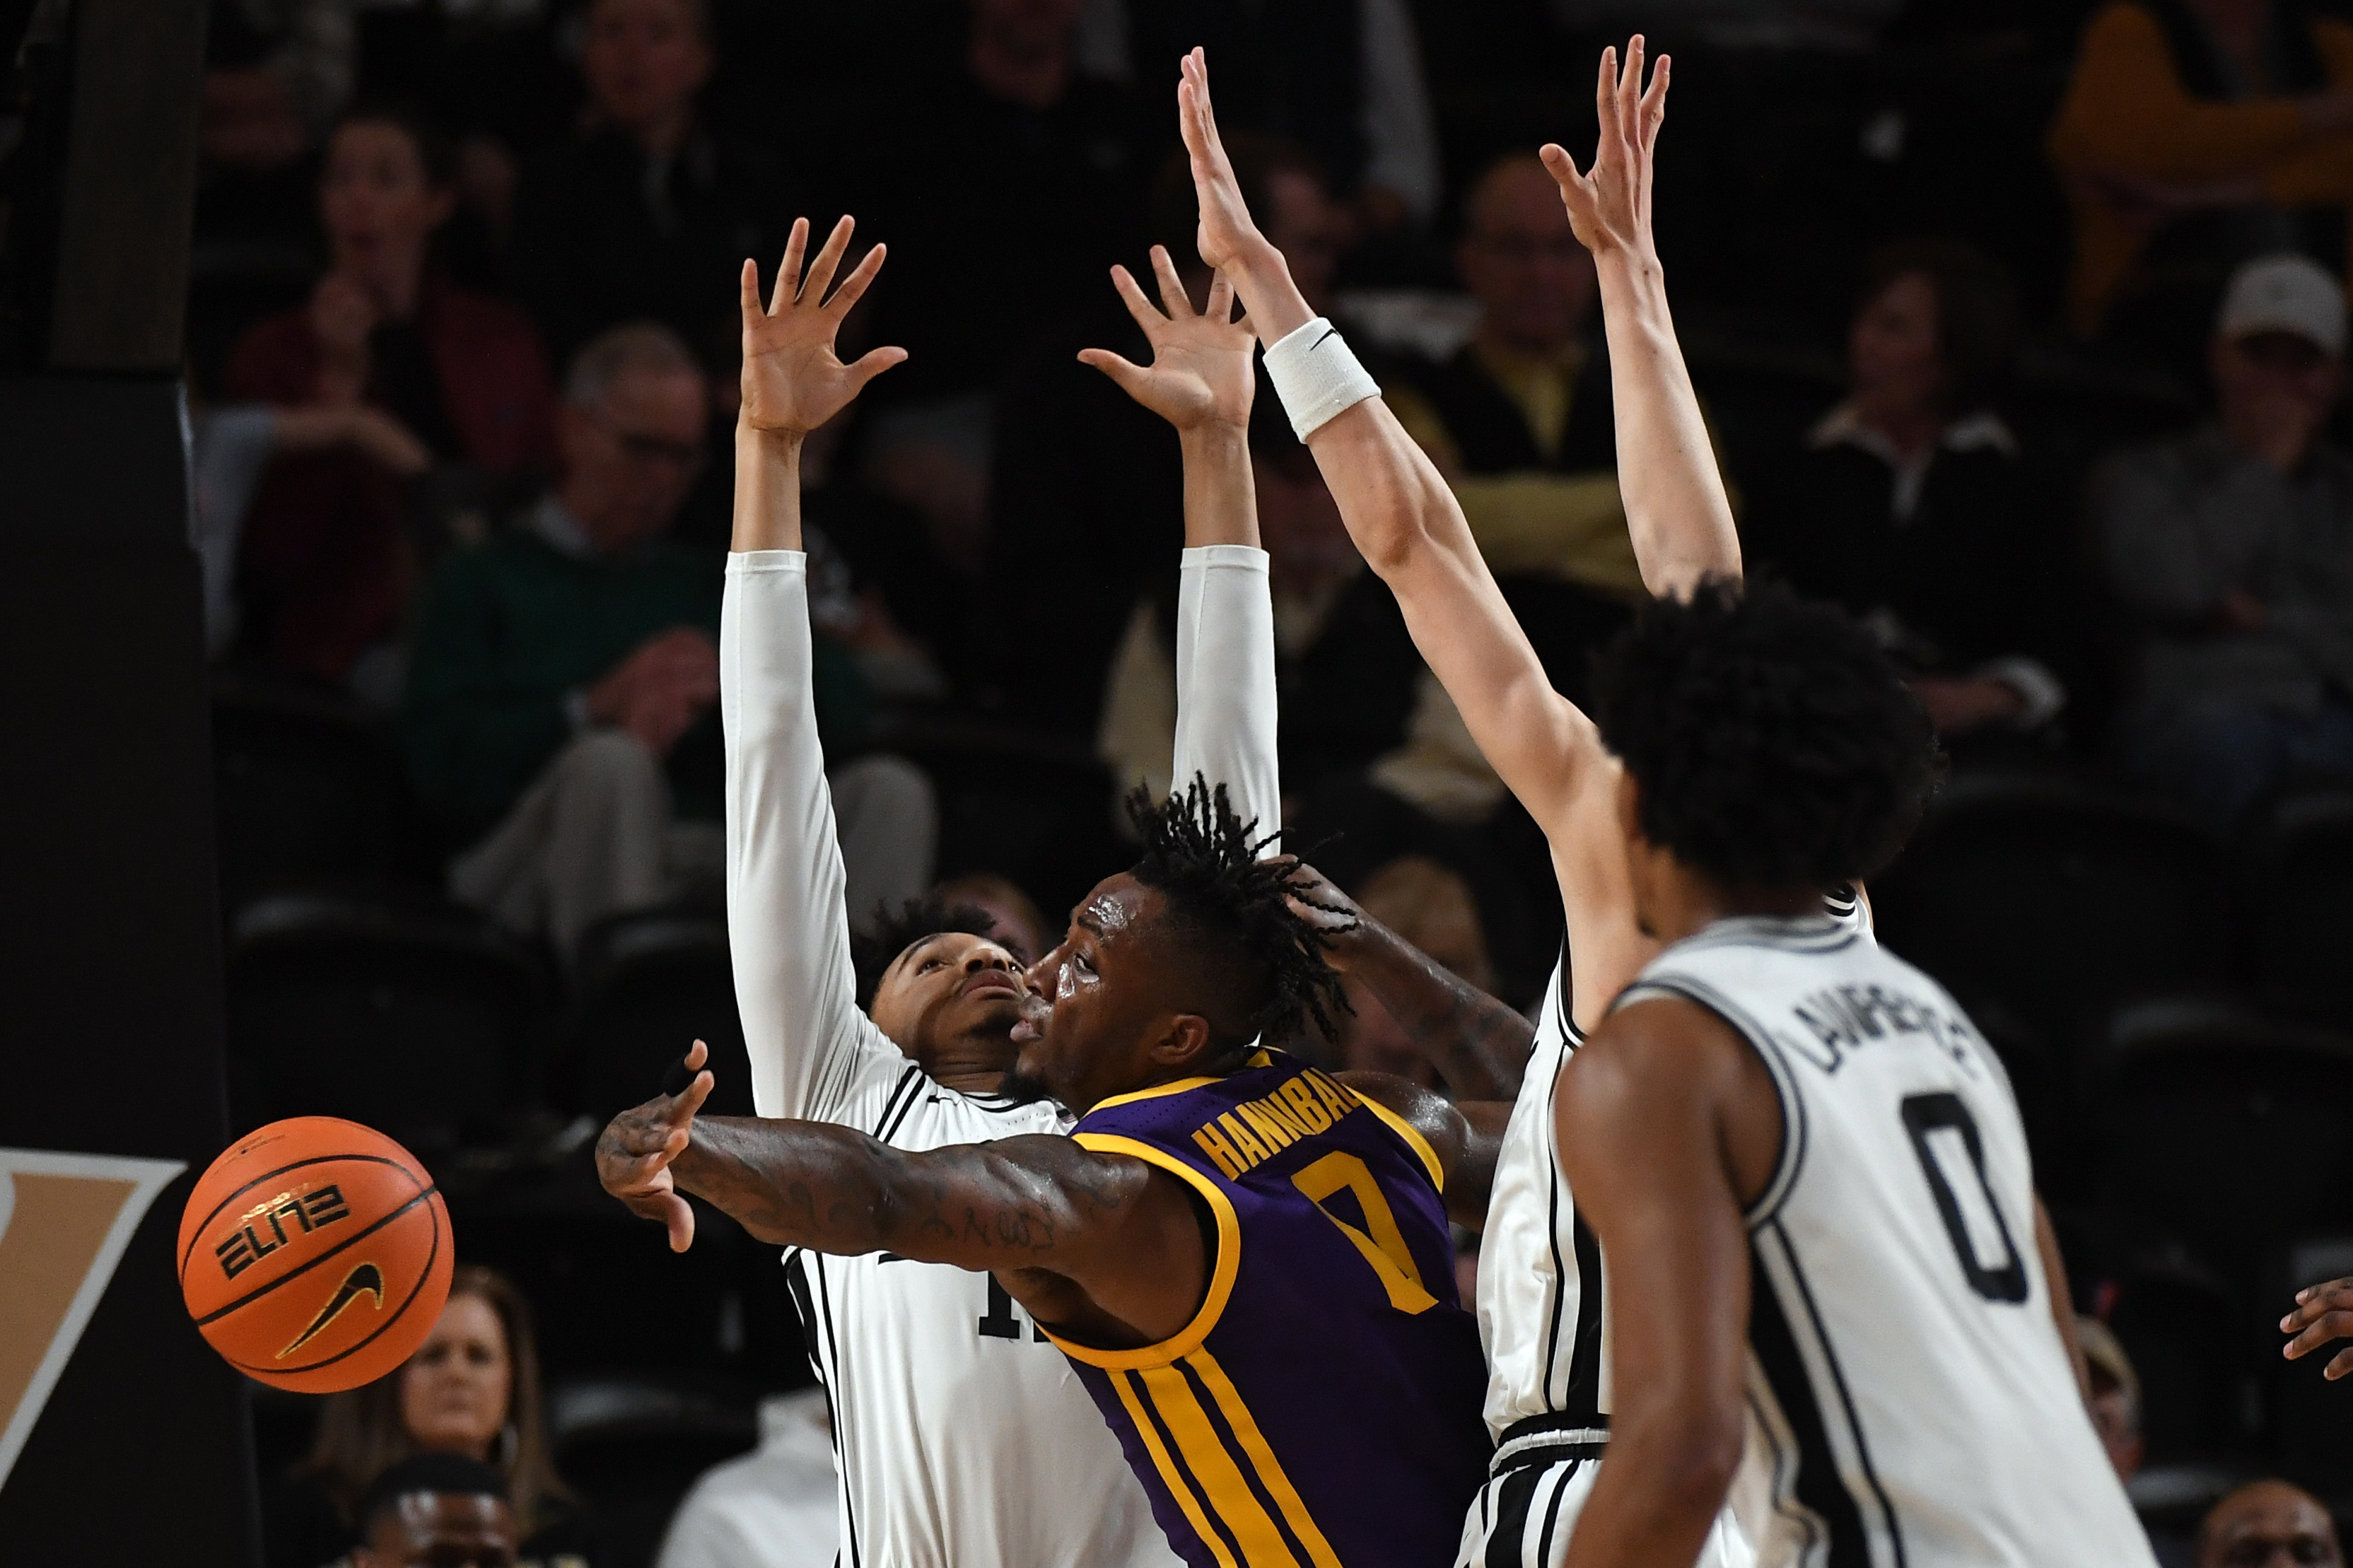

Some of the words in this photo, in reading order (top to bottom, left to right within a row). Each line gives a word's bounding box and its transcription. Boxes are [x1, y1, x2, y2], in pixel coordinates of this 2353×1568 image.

[1191, 1067, 1362, 1181] HANNIBAL
[215, 1184, 351, 1281] ELITE
[1900, 1092, 2030, 1305] 0
